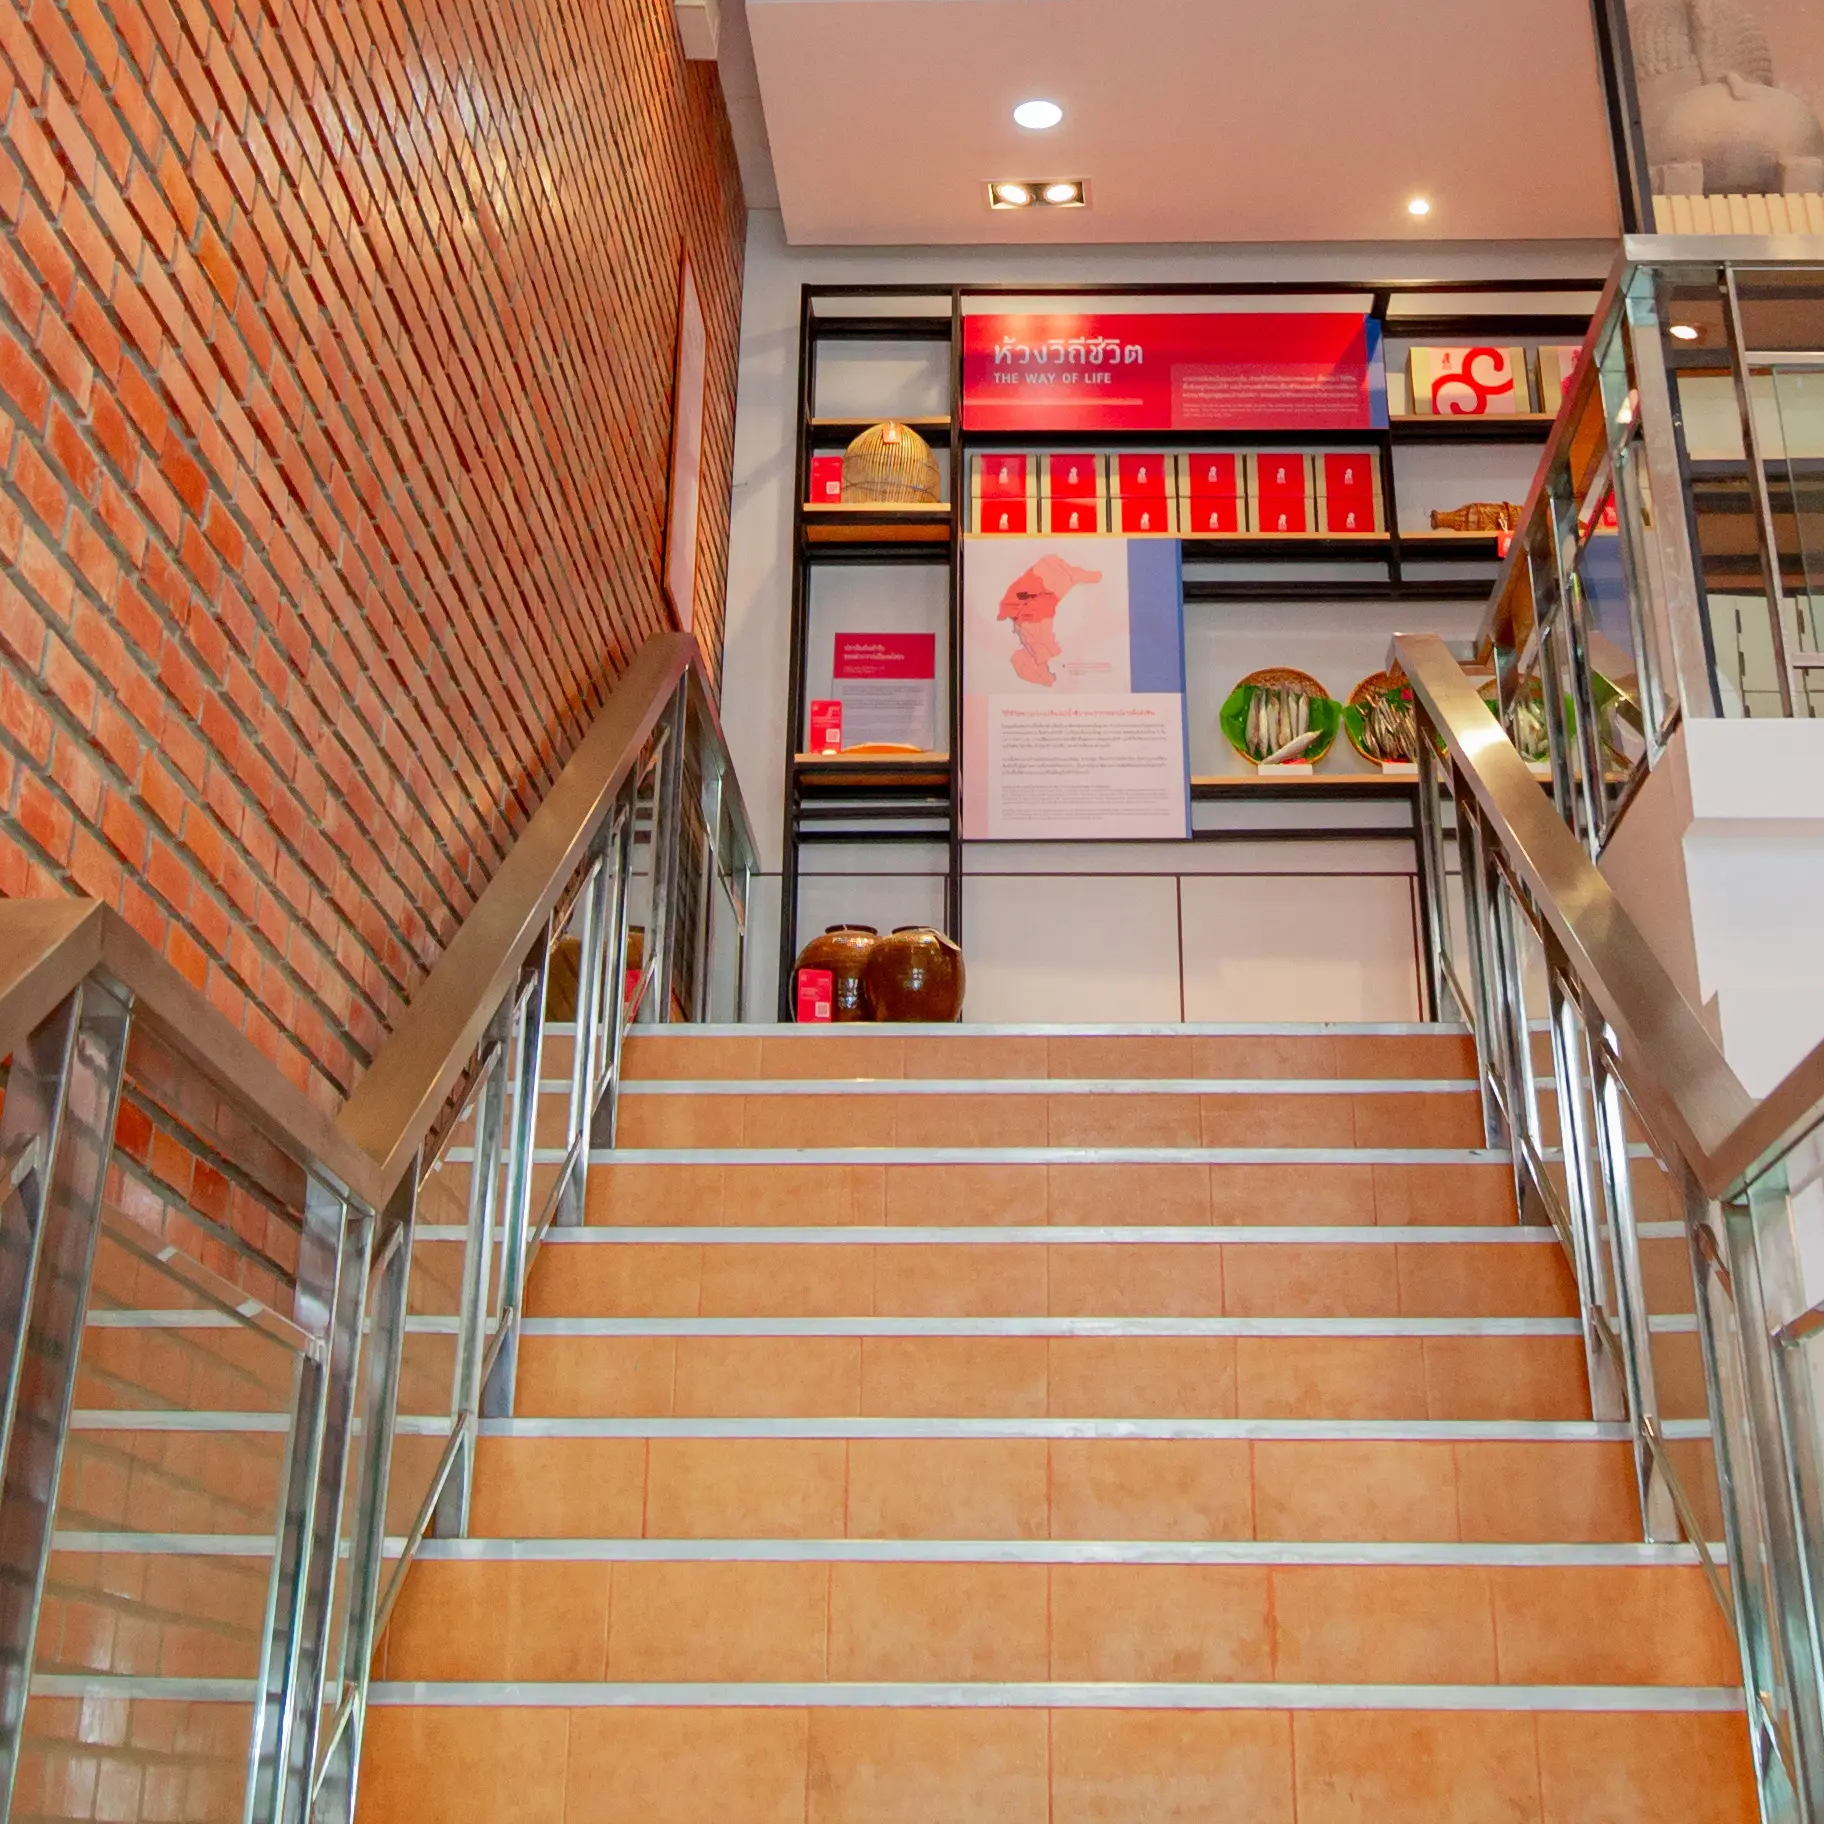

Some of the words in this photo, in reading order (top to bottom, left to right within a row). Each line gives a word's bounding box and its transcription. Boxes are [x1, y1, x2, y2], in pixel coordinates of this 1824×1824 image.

[992, 335, 1144, 366] ห้วงวิถีชีวิต
[993, 372, 1020, 385] THE
[1025, 372, 1056, 385] WAY
[1061, 372, 1080, 385] OF
[1084, 372, 1112, 385] LIFE
